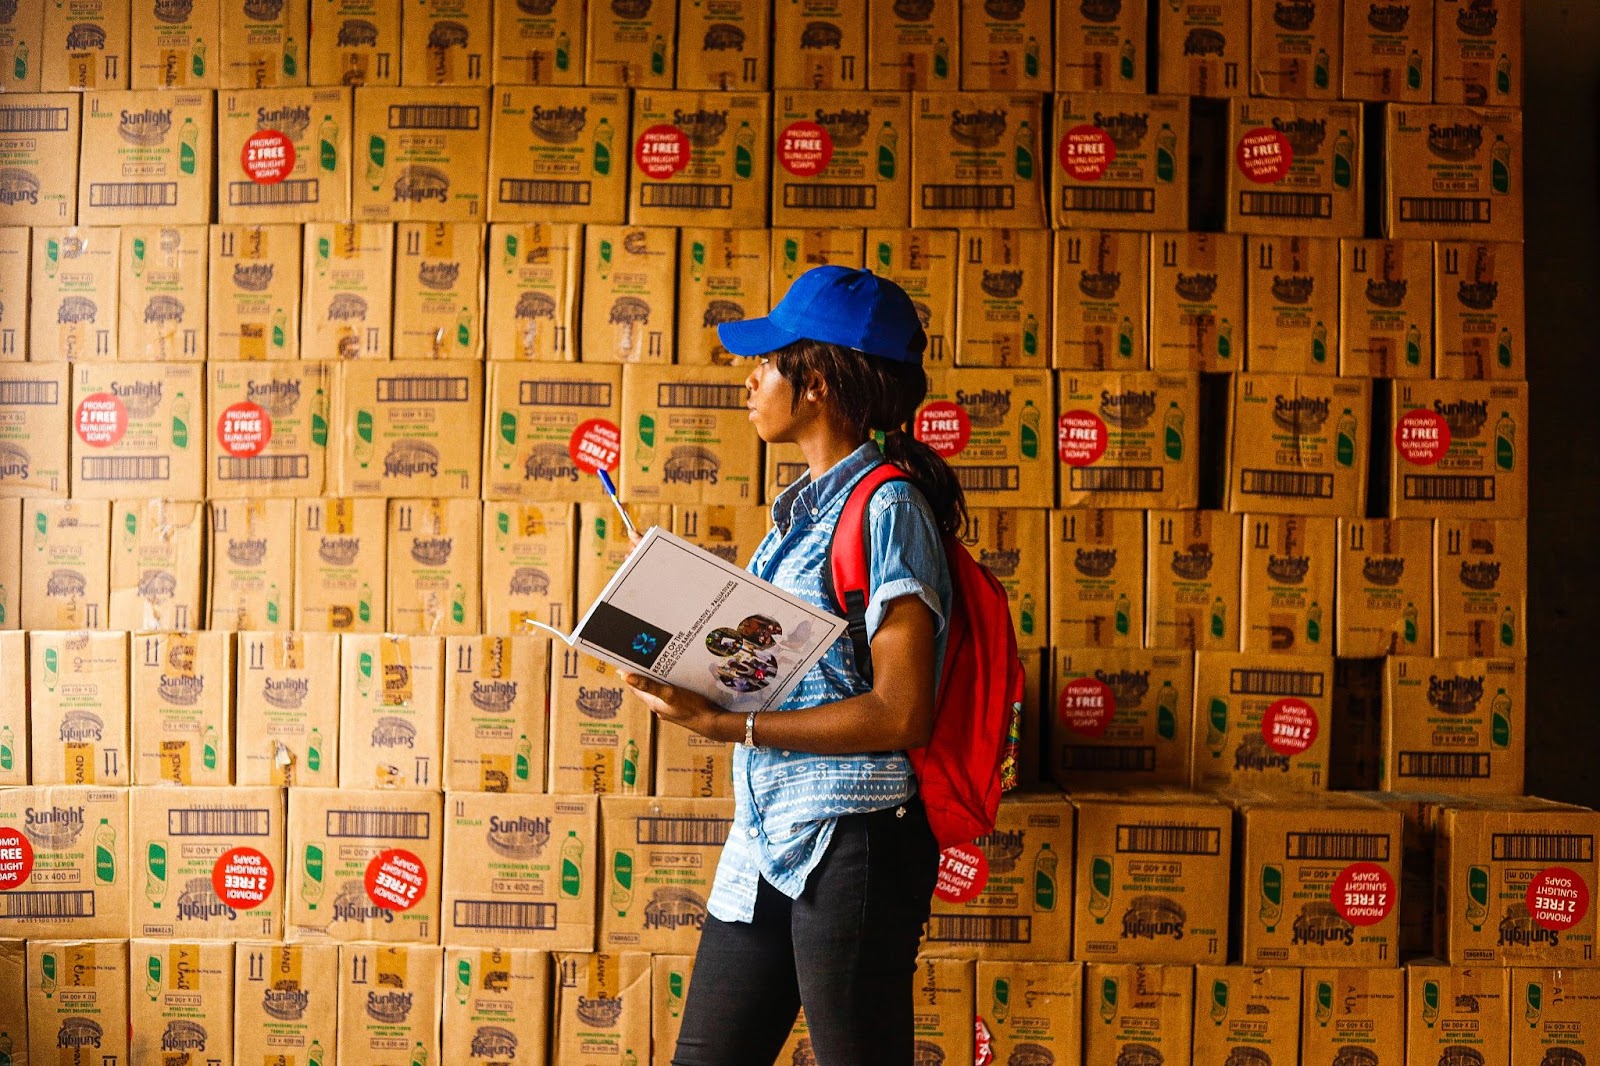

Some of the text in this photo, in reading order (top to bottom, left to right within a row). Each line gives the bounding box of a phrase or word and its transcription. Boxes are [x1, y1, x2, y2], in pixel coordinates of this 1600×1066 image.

[120, 108, 172, 126] Sunlight
[257, 105, 312, 123] Sunlight
[532, 105, 587, 124] Sunlight
[673, 109, 728, 126] Sunlight
[815, 109, 870, 126] Sunlight
[952, 109, 1007, 126] Sunlight
[1093, 112, 1148, 129] Sunlight
[1272, 117, 1326, 135] Sunlight
[1428, 122, 1484, 140] Sunlight
[248, 146, 285, 160] 2 FREE
[642, 143, 679, 154] 2 FREE
[784, 139, 821, 151] 2 FREE
[1067, 143, 1105, 155] 2 FREE
[1242, 143, 1280, 159] 2 FREE
[111, 381, 162, 398] Sunlight
[247, 379, 301, 398] Sunlight
[956, 388, 1011, 406] Sunlight
[1101, 390, 1157, 407] Sunlight
[1274, 394, 1329, 413] Sunlight
[81, 411, 117, 423] 2 FREE
[1434, 399, 1488, 418] Sunlight
[224, 420, 262, 433] 2 FREE
[921, 420, 959, 433] 2 FREE
[1059, 428, 1097, 440] 2 FREE
[1401, 427, 1439, 439] 2 FREE
[578, 439, 608, 460] FREE
[384, 461, 438, 478] Sunlight
[525, 464, 579, 482] Sunlight
[663, 467, 718, 485] Sunlight
[658, 657, 673, 675] LAGOS
[669, 643, 683, 658] FOOD
[680, 629, 693, 644] BANK
[690, 607, 711, 631] INITIATIVE
[651, 630, 686, 673] REPORT OF THE
[1094, 669, 1150, 687] Sunlight
[1428, 674, 1485, 693] Sunlight
[1065, 695, 1103, 707] 2 FREE
[1272, 722, 1301, 737] FREE
[25, 806, 84, 826] Sunlight
[490, 815, 551, 836] Sunlight
[35, 860, 75, 868] TURBO LEMON
[65, 852, 85, 860] LIQUID
[233, 854, 261, 866] SOAPS
[392, 855, 421, 874] SOAPS
[33, 872, 42, 881] 10
[52, 872, 67, 881] 400
[225, 863, 268, 876] SUNLIGHT
[946, 858, 978, 881] FREE
[1351, 872, 1380, 881] SOAPS
[224, 875, 267, 891] 2 FREE
[375, 871, 418, 899] 2 FREE
[1344, 882, 1387, 893] SUNLIGHT
[1544, 876, 1572, 888] SOAPS
[226, 890, 264, 901] PROMO!
[373, 886, 410, 908] PROMO!
[1344, 893, 1387, 906] 2 FREE
[1535, 886, 1578, 899] SUNLIGHT
[177, 902, 237, 921] Sunlight
[1347, 907, 1384, 917] PROMO!
[1534, 896, 1577, 913] 2 FREE
[333, 903, 394, 924] Sunlight
[1536, 911, 1572, 923] PROMO!
[1122, 921, 1184, 941] Sunlight
[1292, 926, 1354, 946] Sunlight
[1497, 927, 1559, 948] Sunlight
